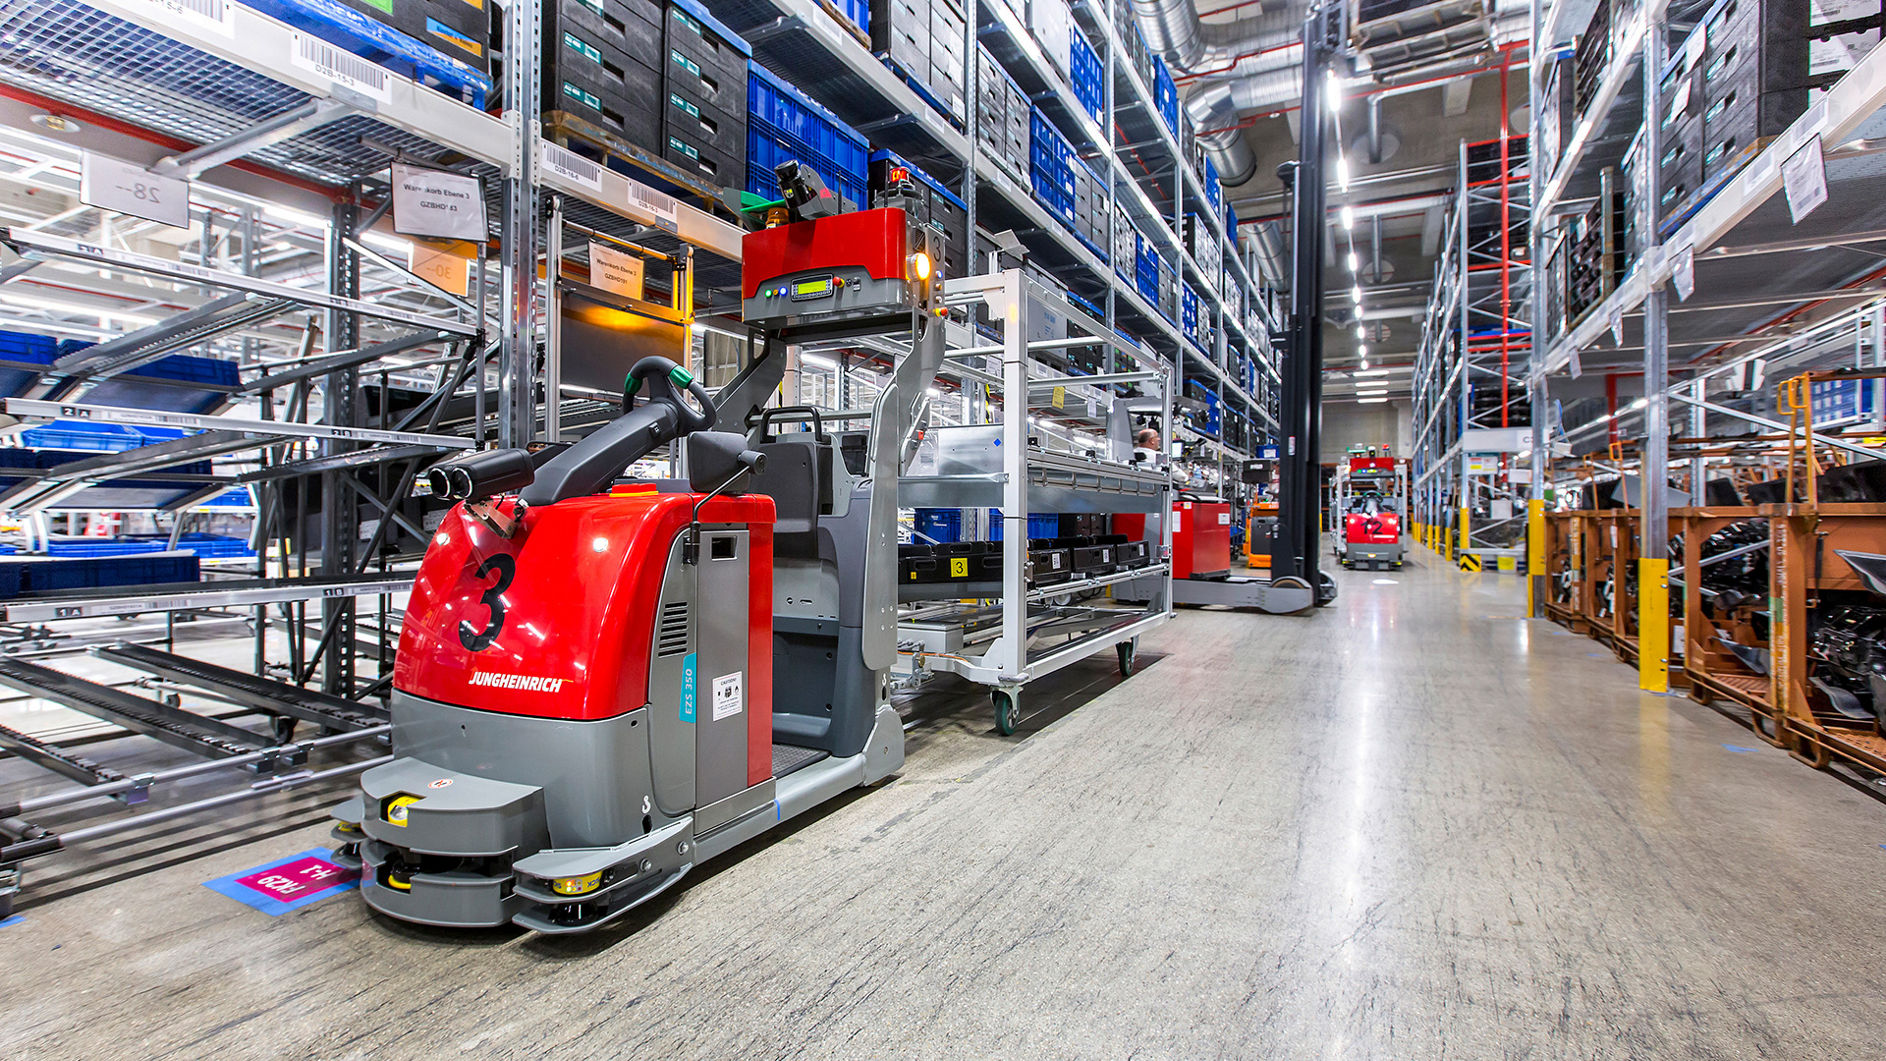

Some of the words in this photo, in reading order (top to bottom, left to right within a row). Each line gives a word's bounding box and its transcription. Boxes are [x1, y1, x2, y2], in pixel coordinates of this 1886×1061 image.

[403, 183, 442, 196] Warekorb
[933, 235, 942, 263] 3
[1361, 521, 1383, 535] 12
[955, 561, 964, 574] 3
[458, 553, 516, 652] 3
[468, 672, 562, 693] JUNGHEINRICH
[685, 668, 693, 691] 350
[685, 694, 693, 715] EZS
[257, 875, 306, 895] FK29
